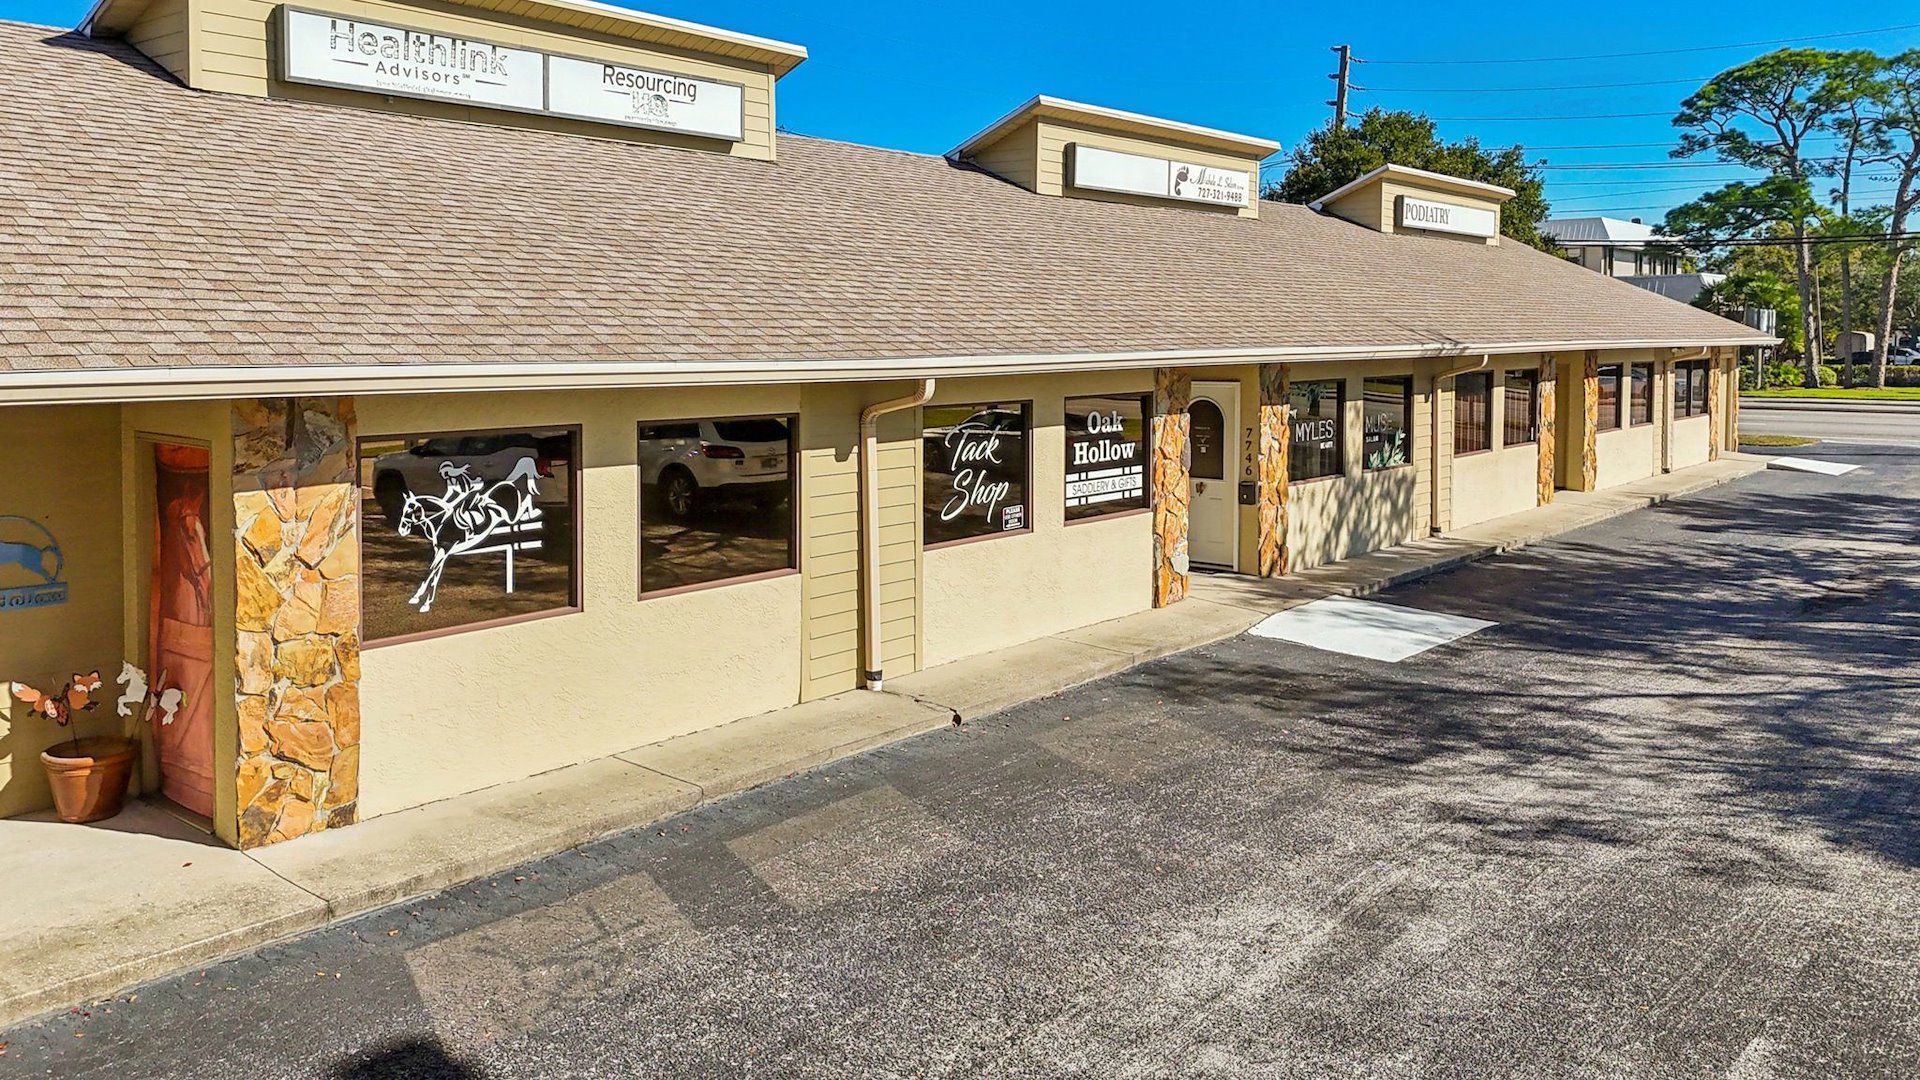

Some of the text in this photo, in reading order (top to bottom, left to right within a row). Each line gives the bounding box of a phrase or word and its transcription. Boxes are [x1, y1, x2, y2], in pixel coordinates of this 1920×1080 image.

[330, 19, 508, 77] Healthlink
[375, 60, 460, 85] Advisors
[602, 64, 697, 102] Resourcing
[1405, 203, 1451, 225] PODIATRY
[1087, 410, 1124, 434] Oak
[1295, 419, 1334, 442] MYLES
[1365, 412, 1393, 433] MUSE
[944, 421, 1003, 471] Tack
[1073, 440, 1136, 465] Hollow
[940, 468, 1010, 523] Shop
[1072, 476, 1137, 495] SADDLERY & GIFTS
